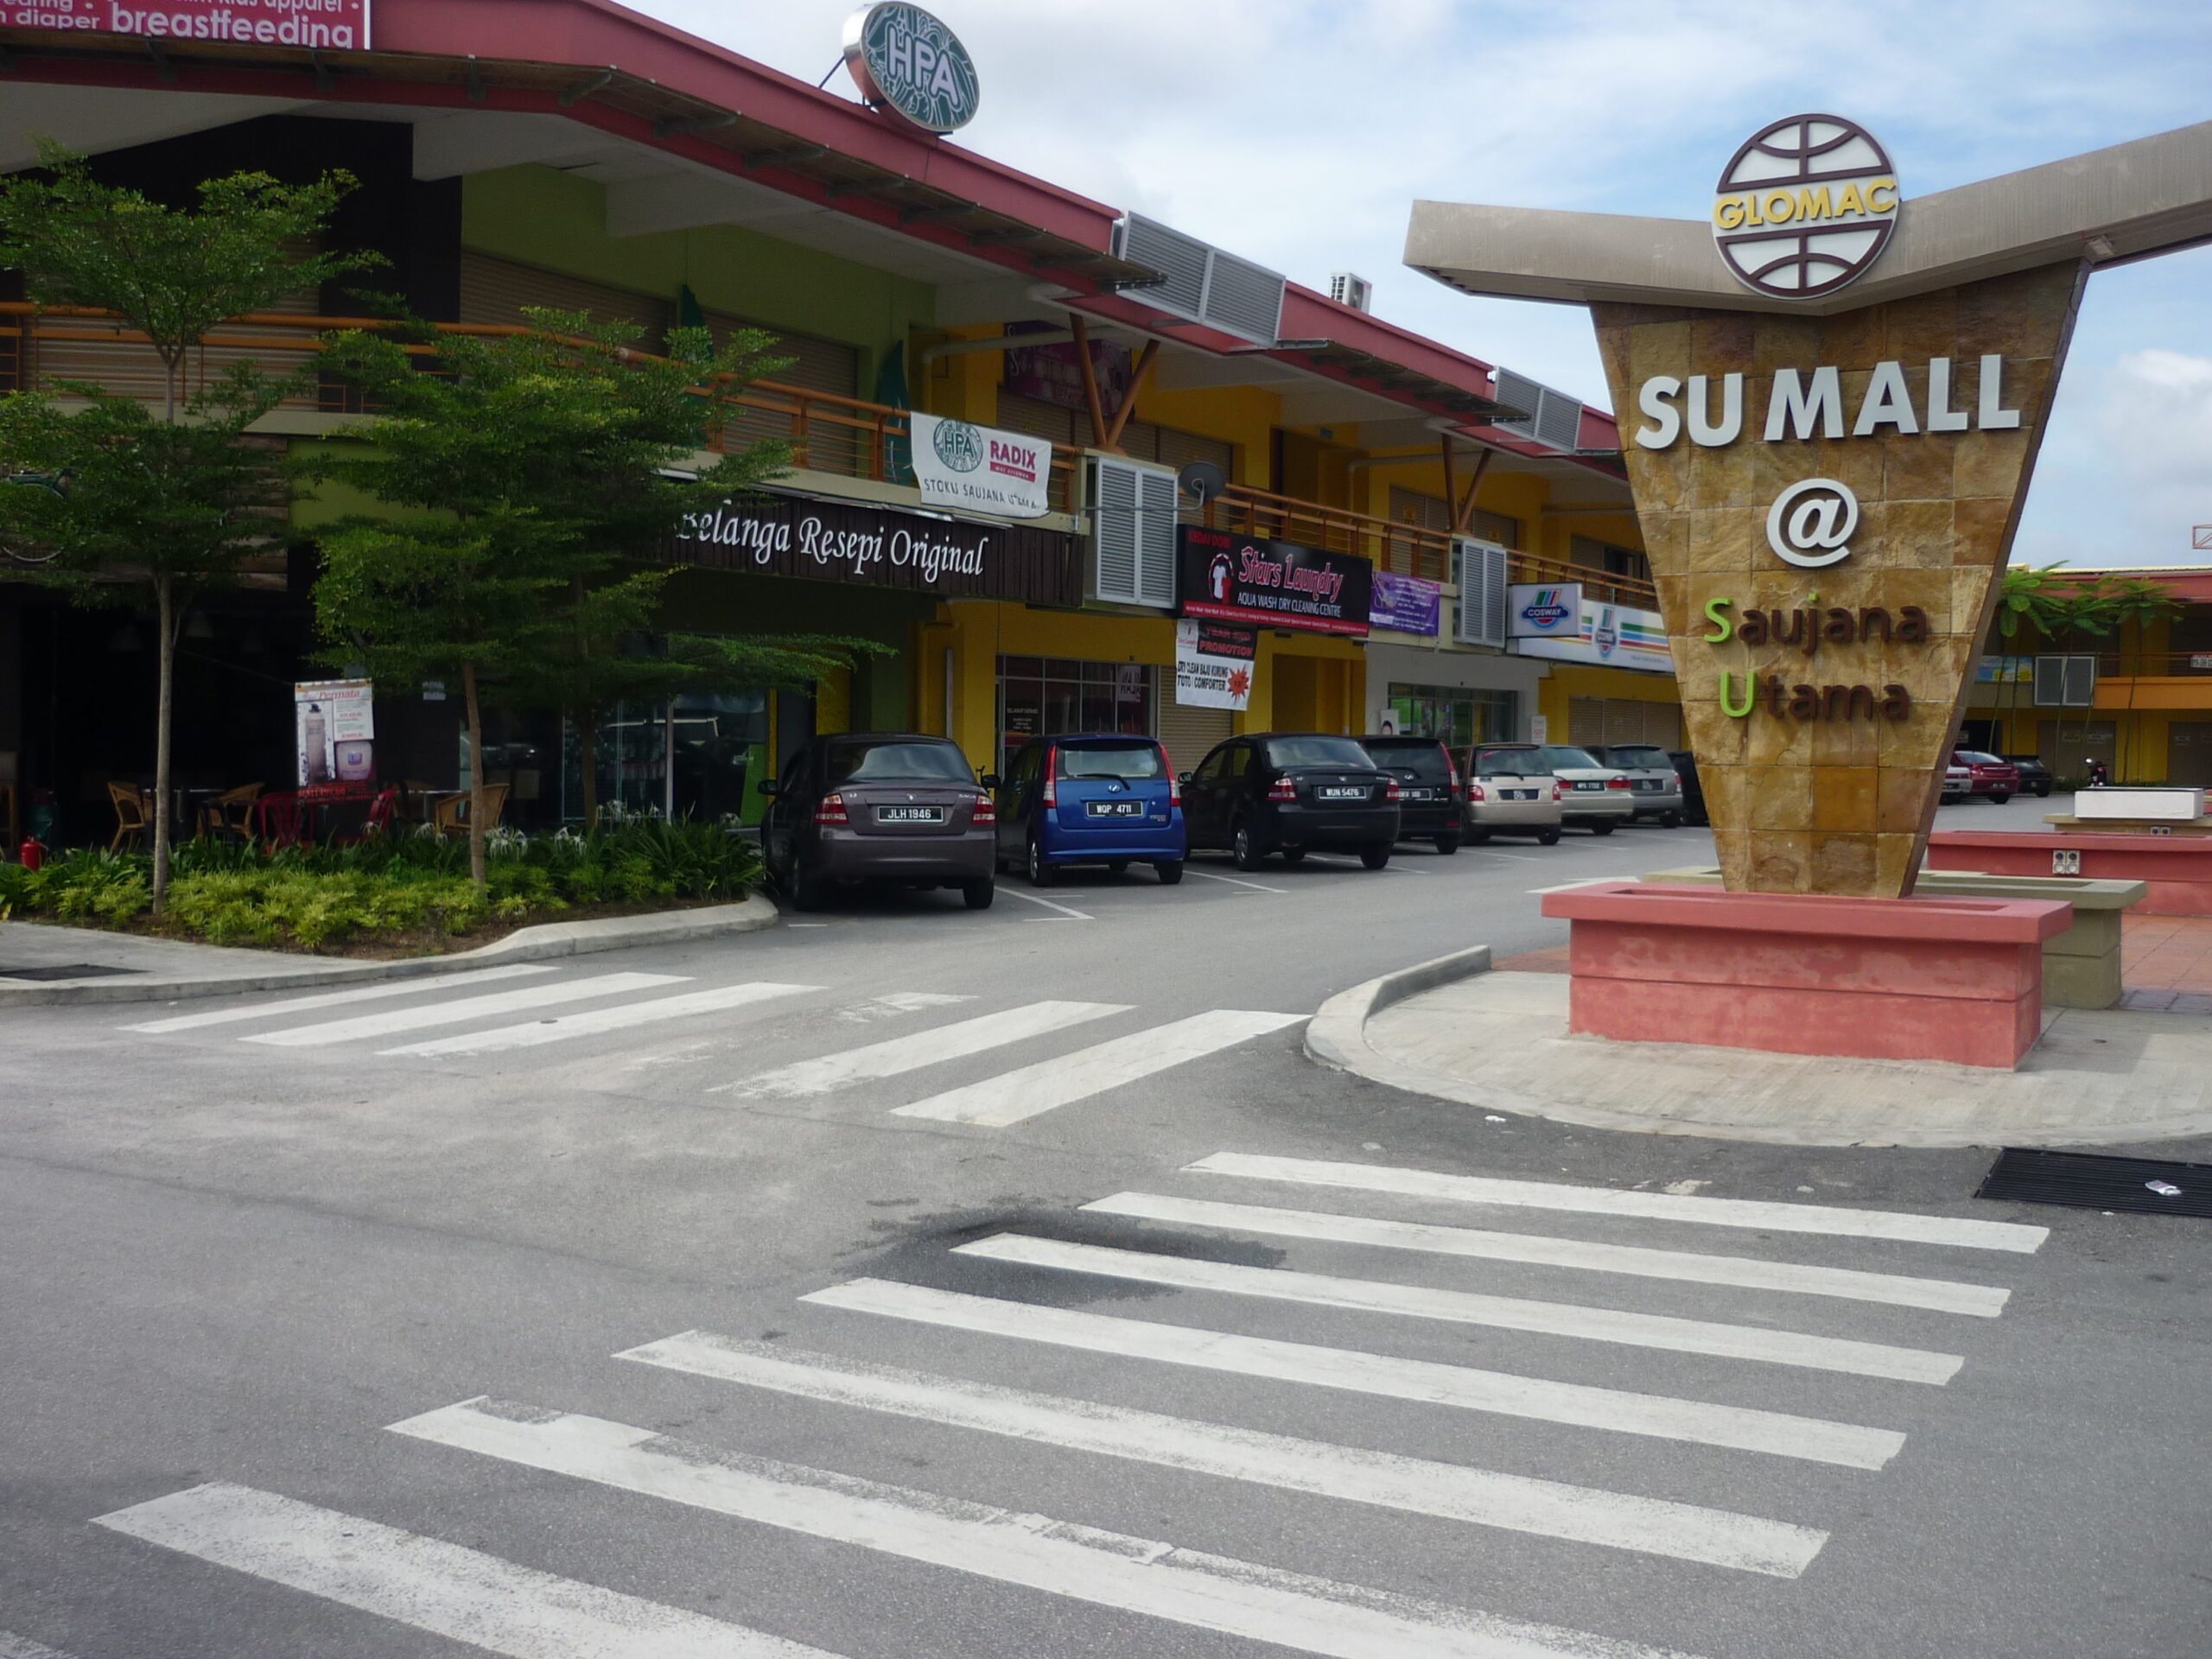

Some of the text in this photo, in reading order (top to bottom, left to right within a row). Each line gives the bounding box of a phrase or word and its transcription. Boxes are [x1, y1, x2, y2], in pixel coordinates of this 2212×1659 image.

[16, 9, 101, 29] diaper
[111, 3, 353, 49] breastfeeding
[887, 23, 961, 110] HPA
[1713, 179, 1897, 229] GLOMAC
[1635, 353, 2020, 449] SU MALL
[944, 430, 975, 459] HPA
[989, 440, 1037, 471] RADIX
[963, 484, 1006, 504] SAUJANA
[1766, 478, 1859, 567] @
[798, 516, 883, 575] Resepi
[890, 530, 988, 583] Original
[1238, 545, 1282, 588] Stars
[1283, 553, 1344, 603] Laundry
[1237, 592, 1342, 618] AQUA WASH DRY CLEANING CENTRE
[1528, 607, 1562, 617] COSWAY
[1703, 593, 1927, 655] Saujana
[1199, 640, 1253, 657] PROMOTION
[1186, 662, 1199, 675] CLEAN
[1194, 677, 1226, 691] COMFORTER
[1719, 671, 1910, 721] Utama
[1325, 788, 1341, 797] WUN
[887, 809, 932, 819] JLH 1946
[1116, 804, 1132, 814] 4711
